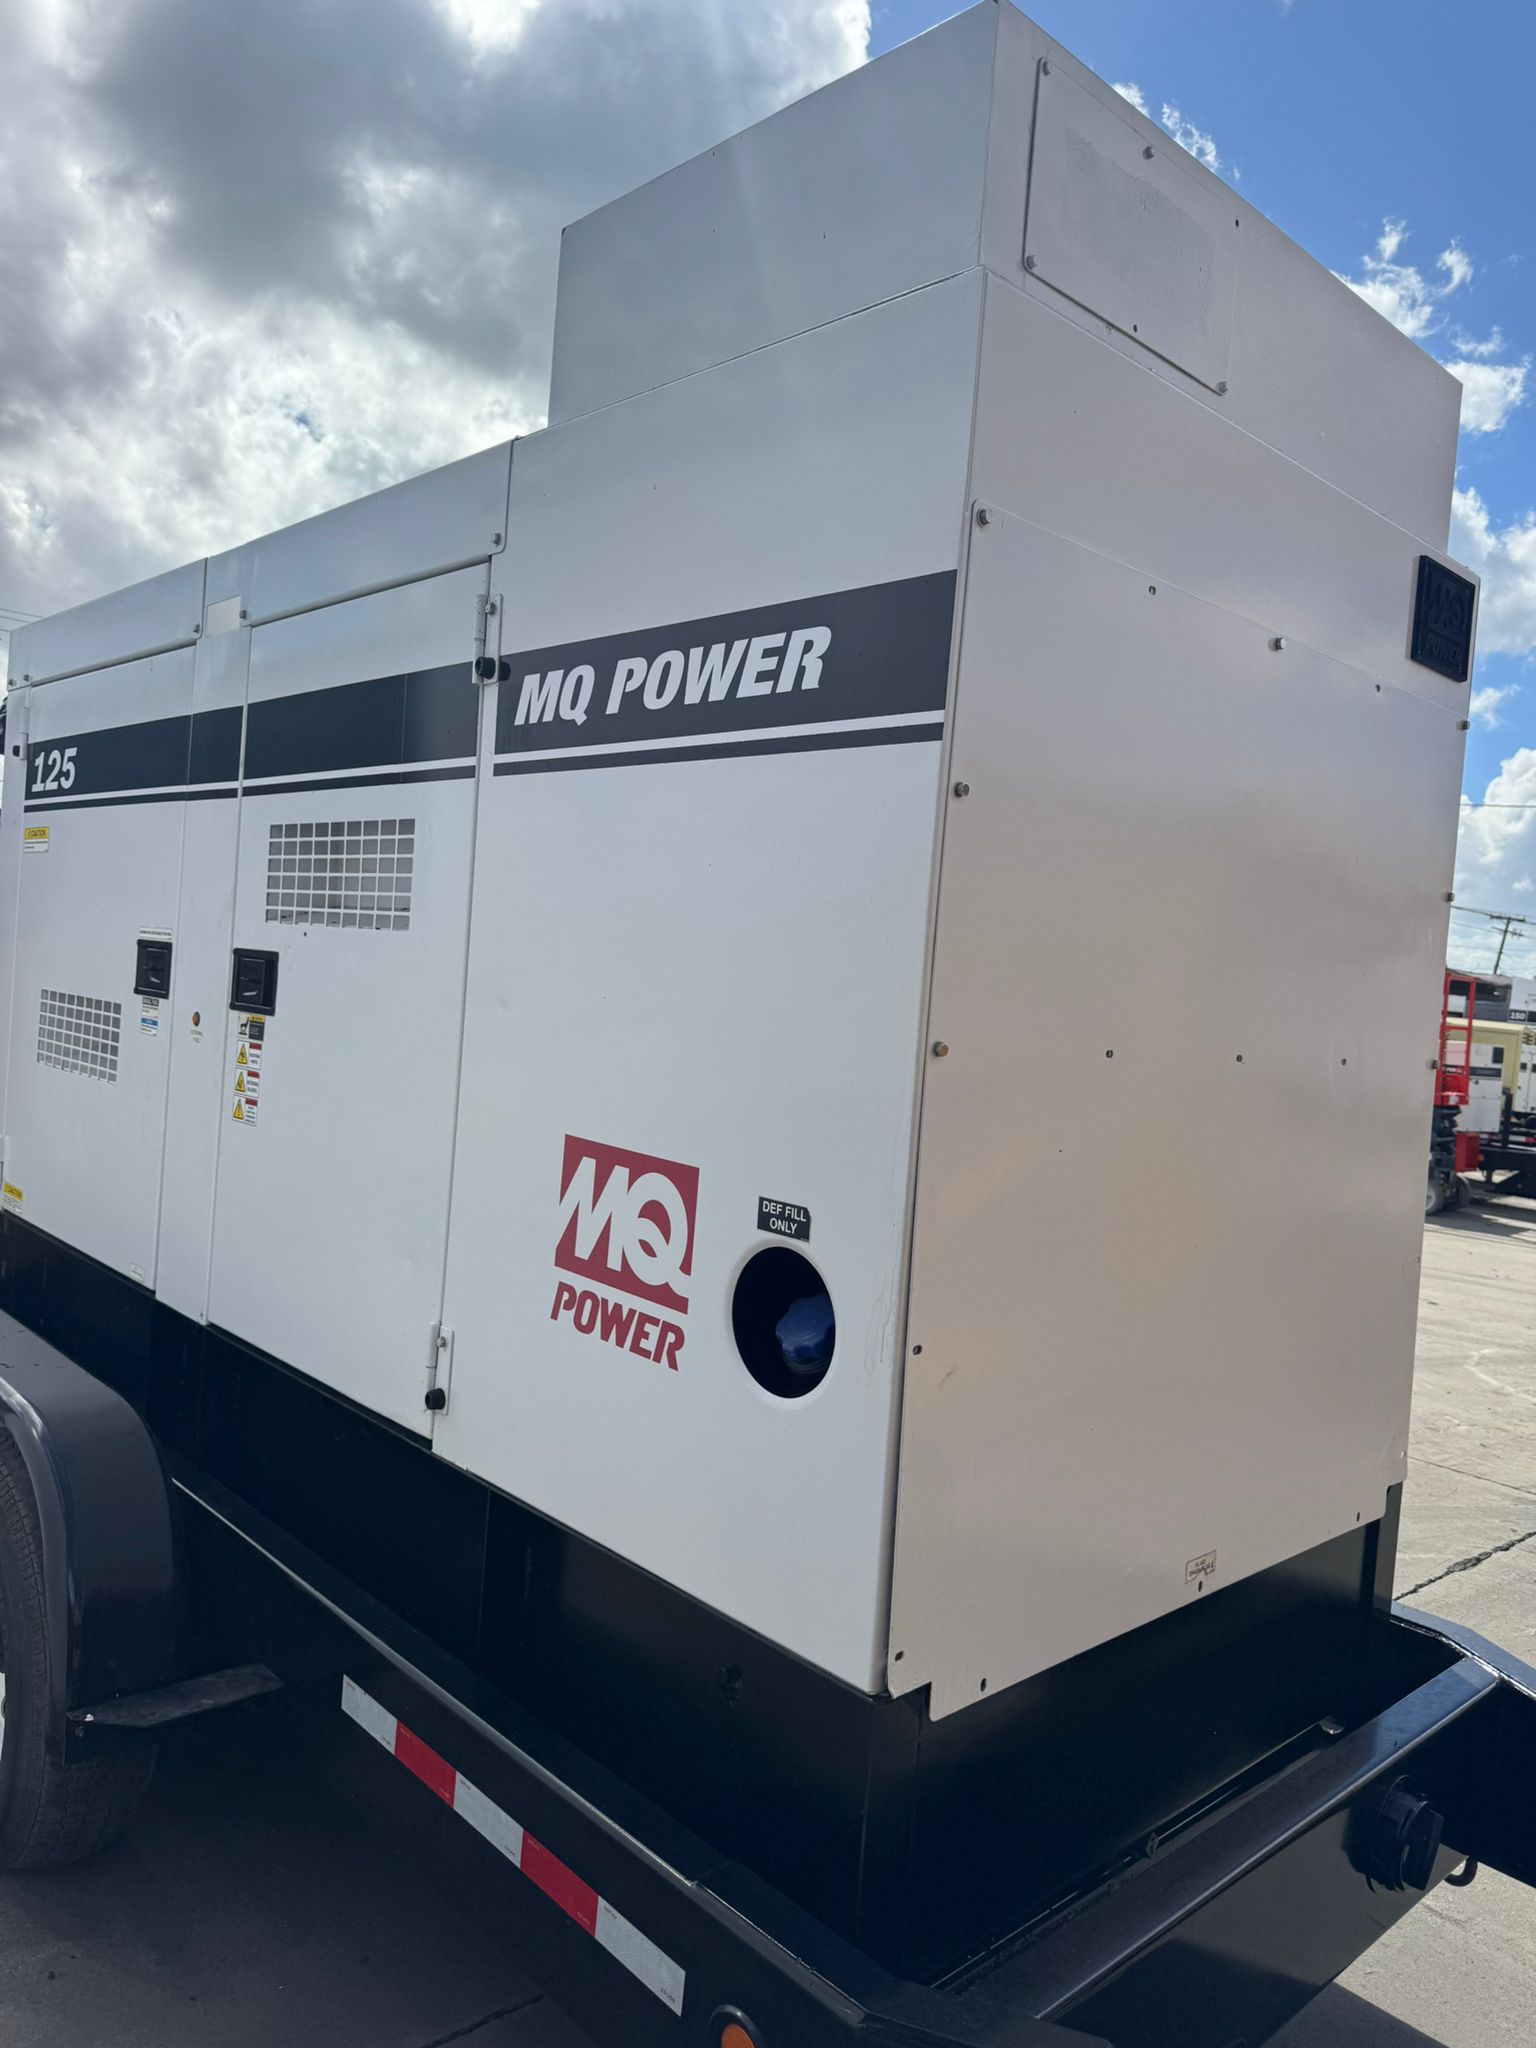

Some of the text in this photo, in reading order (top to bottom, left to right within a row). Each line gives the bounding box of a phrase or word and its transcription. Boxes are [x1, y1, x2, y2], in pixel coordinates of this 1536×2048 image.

[514, 625, 833, 726] MQ POWER
[31, 747, 77, 792] 125
[555, 1154, 692, 1301] MQ
[763, 1200, 807, 1222] DEF FILL
[770, 1218, 797, 1234] ONLY
[550, 1281, 685, 1372] POWER
